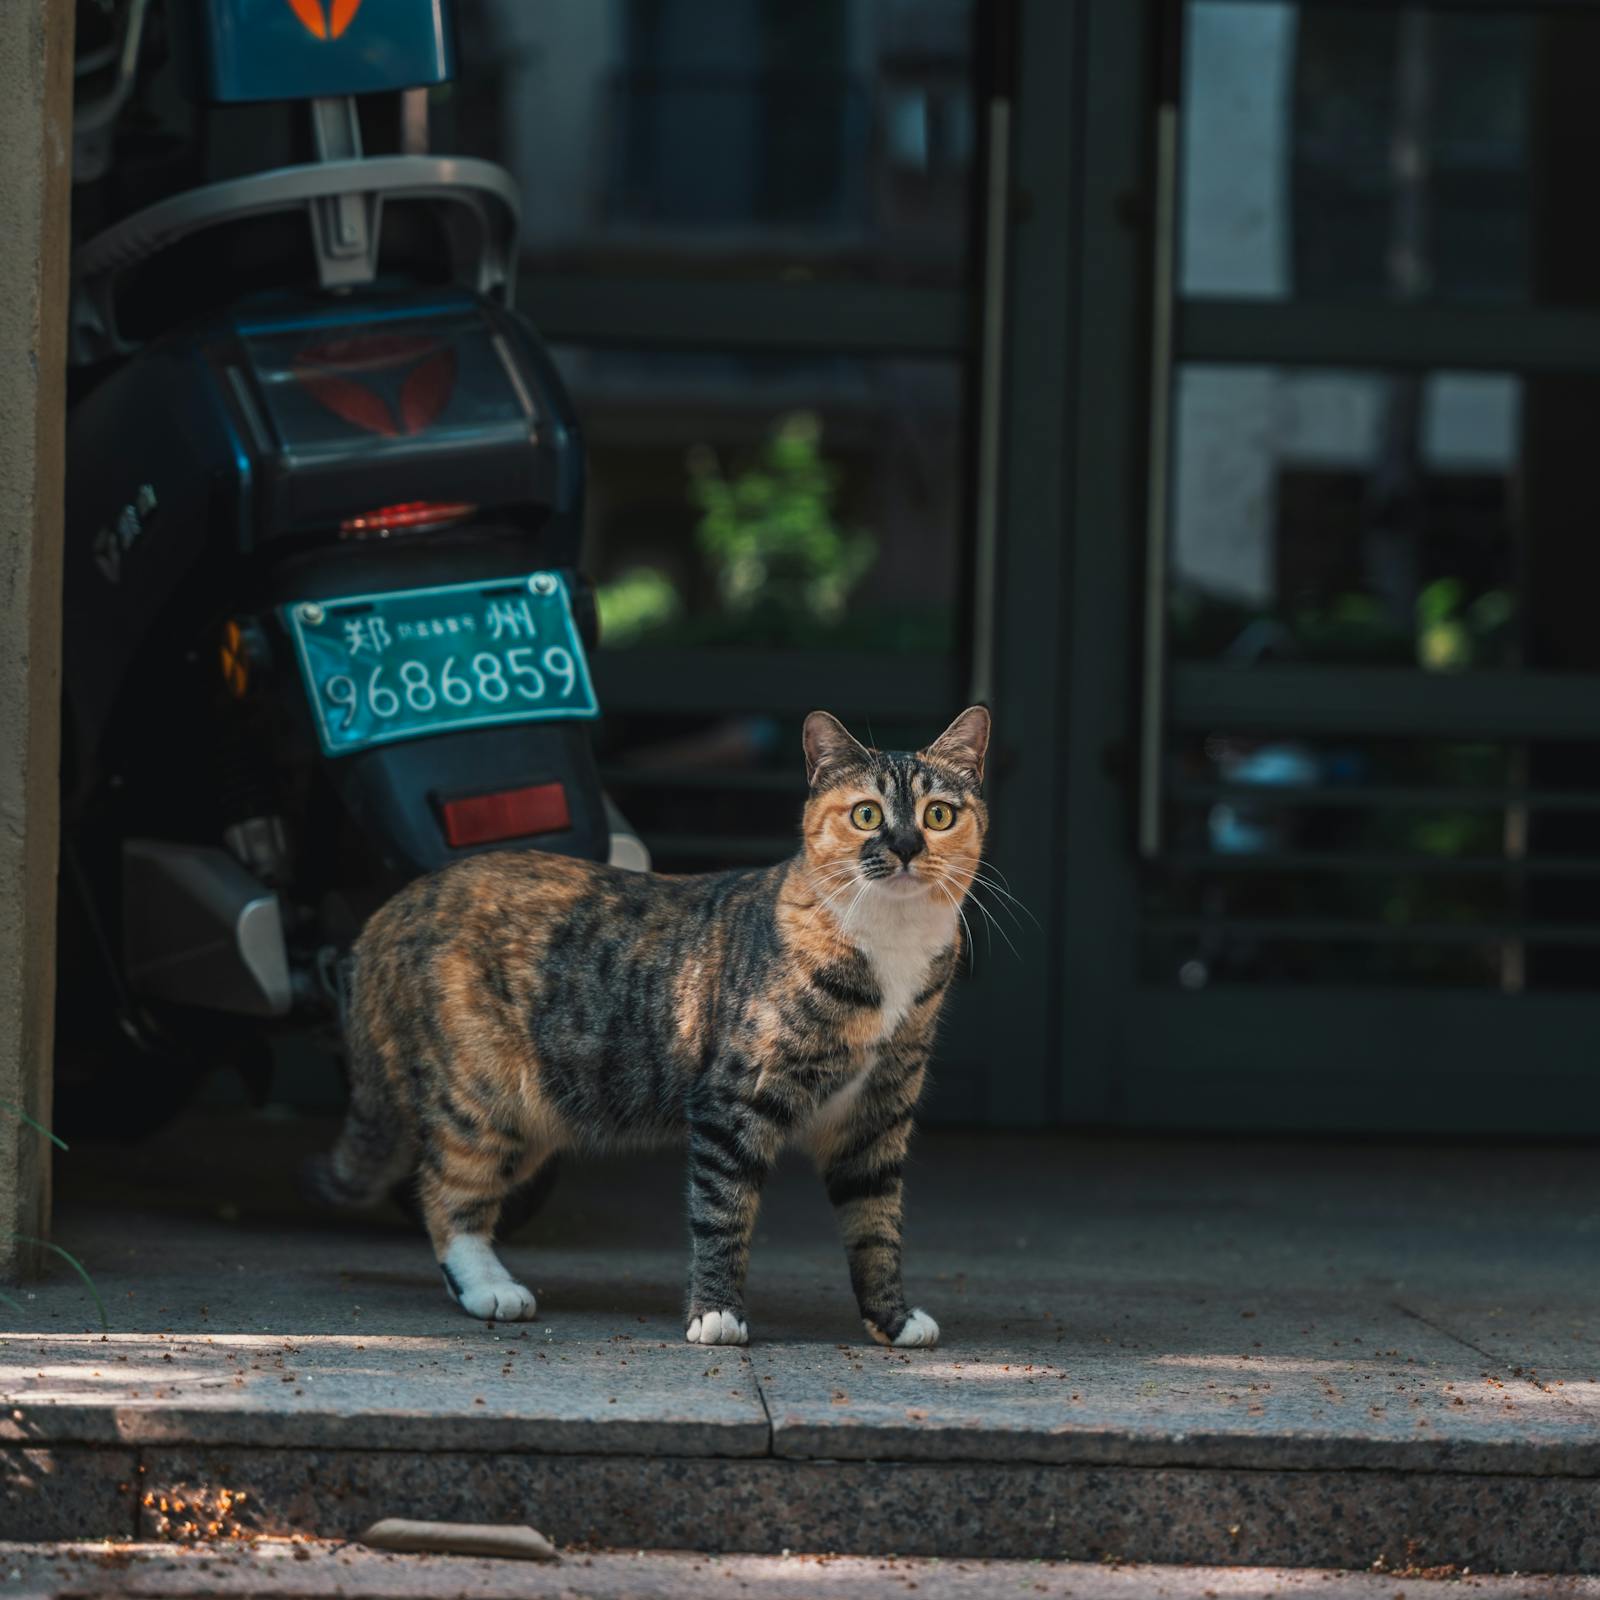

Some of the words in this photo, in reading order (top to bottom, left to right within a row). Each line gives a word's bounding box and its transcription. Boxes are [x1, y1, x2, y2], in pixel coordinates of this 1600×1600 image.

[344, 616, 392, 655] 郑
[486, 599, 536, 640] 州
[325, 646, 576, 729] 9686859
